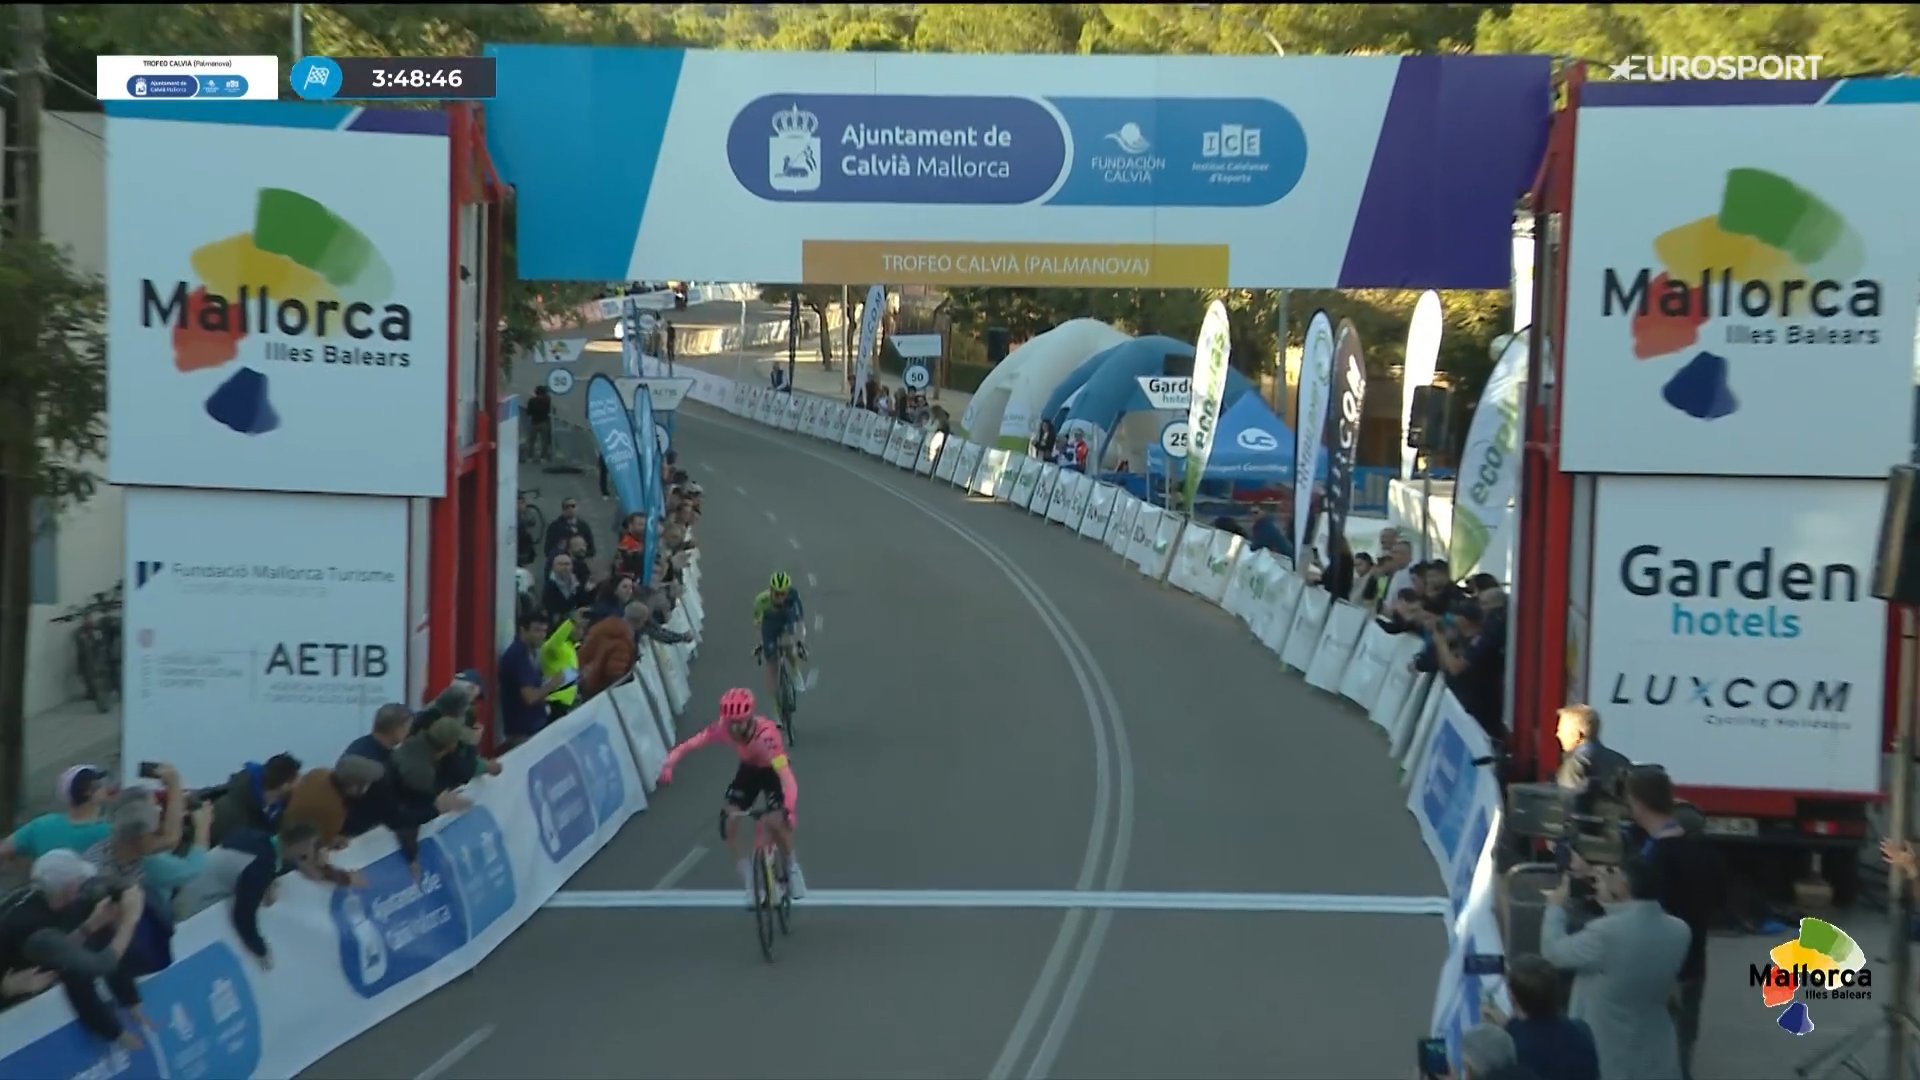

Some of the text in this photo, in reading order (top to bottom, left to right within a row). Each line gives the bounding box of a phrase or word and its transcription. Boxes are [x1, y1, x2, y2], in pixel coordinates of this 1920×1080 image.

[841, 124, 1012, 152] Ajuntament de
[841, 154, 1010, 179] Calvià Mallorca
[882, 254, 952, 273] TROFEO
[1024, 253, 1151, 277] (PALMANOVA)
[1602, 267, 1882, 318] Mallorca
[140, 278, 412, 342] Mallorca
[1725, 325, 1881, 345] Illes Balears
[264, 341, 411, 368] Illes Balears
[911, 372, 924, 382] 50
[1149, 378, 1193, 394] Gard
[1170, 432, 1188, 447] 25
[1620, 544, 1859, 601] Garden
[1671, 602, 1801, 638] hotels
[265, 642, 388, 678] AETIB
[1611, 672, 1852, 712] LUXCOM
